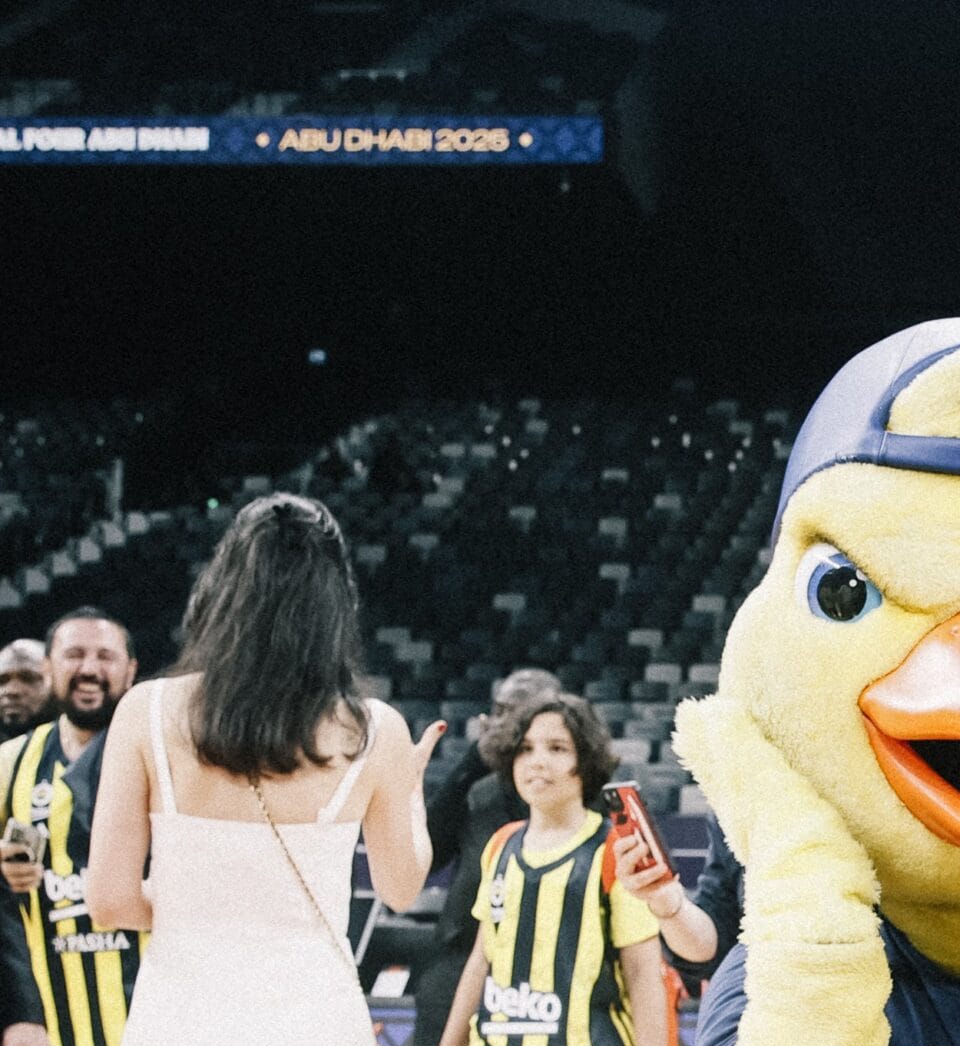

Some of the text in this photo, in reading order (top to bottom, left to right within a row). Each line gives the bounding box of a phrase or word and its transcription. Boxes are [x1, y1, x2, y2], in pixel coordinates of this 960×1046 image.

[279, 128, 510, 152] ABU DHABI 2025
[484, 976, 562, 1022] beko
